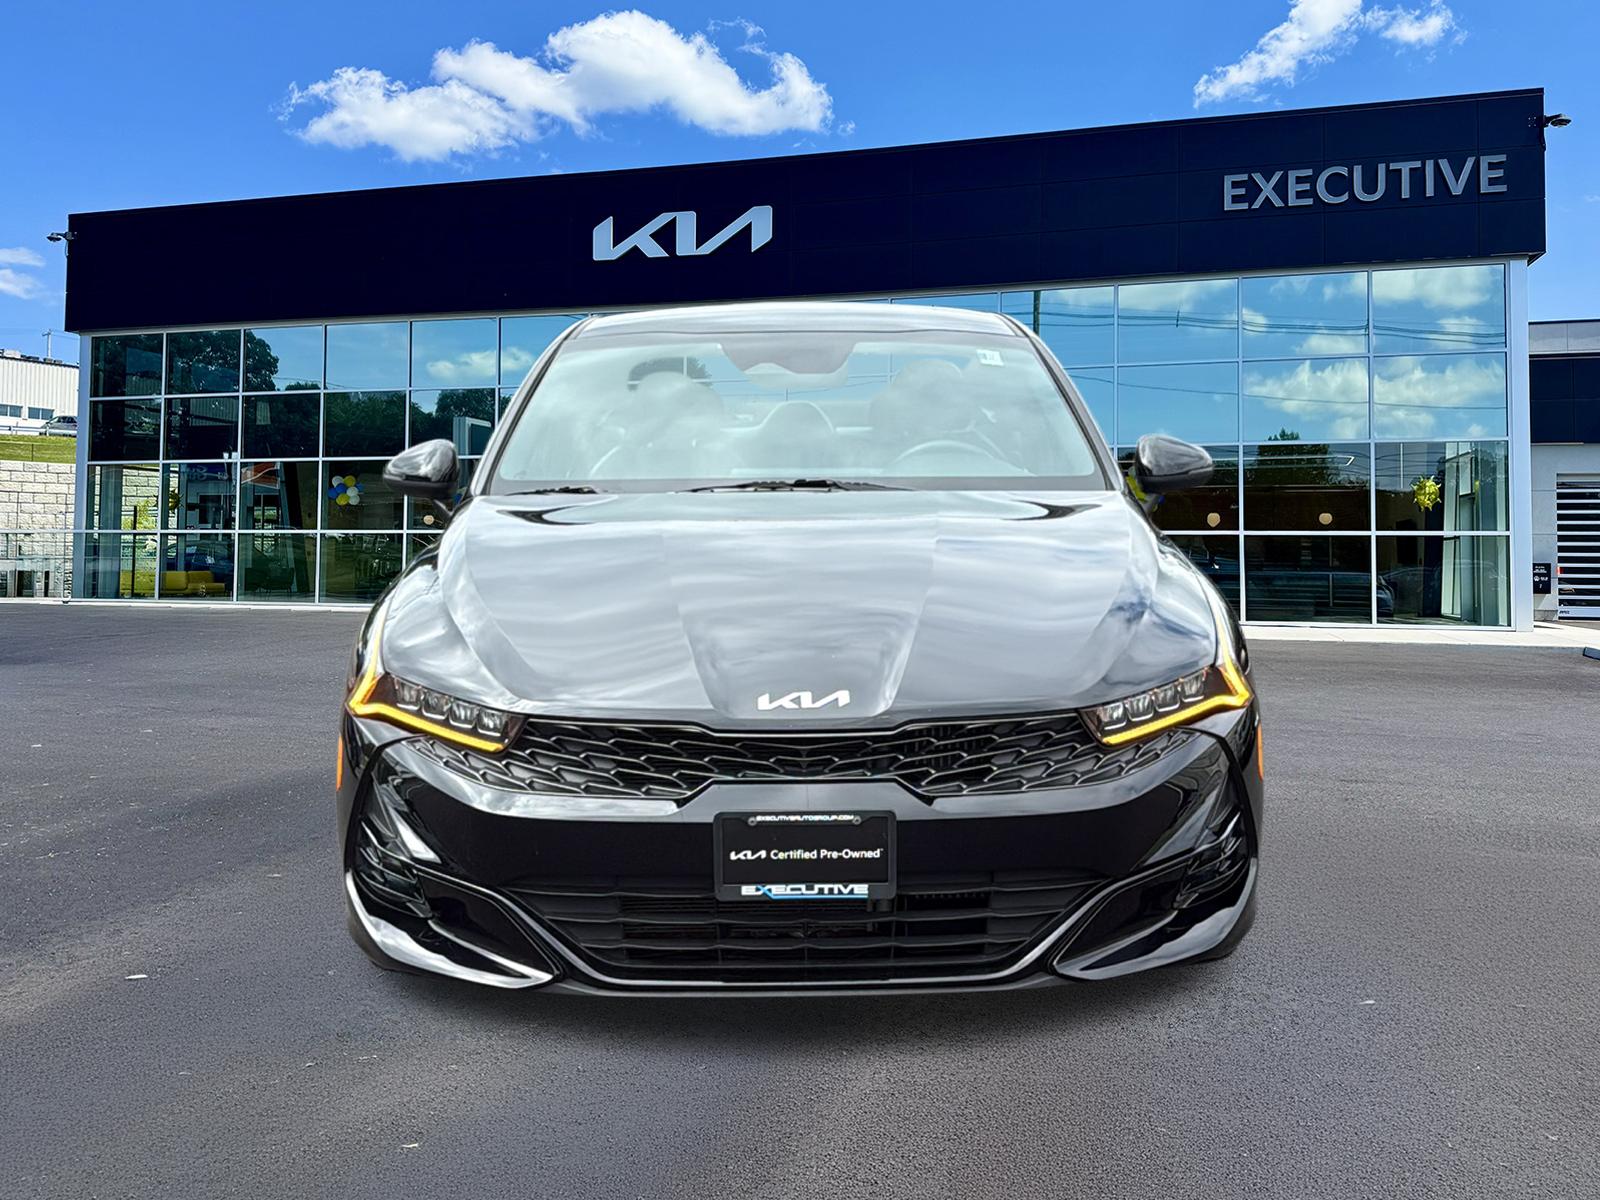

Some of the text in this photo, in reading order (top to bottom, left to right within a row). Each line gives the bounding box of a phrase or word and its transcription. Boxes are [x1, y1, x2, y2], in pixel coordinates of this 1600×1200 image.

[1223, 154, 1508, 211] EXECUTIVE
[593, 206, 773, 261] KIA
[758, 690, 850, 710] KIA
[770, 850, 817, 860] Certified
[741, 884, 868, 896] EXECUTIVE
